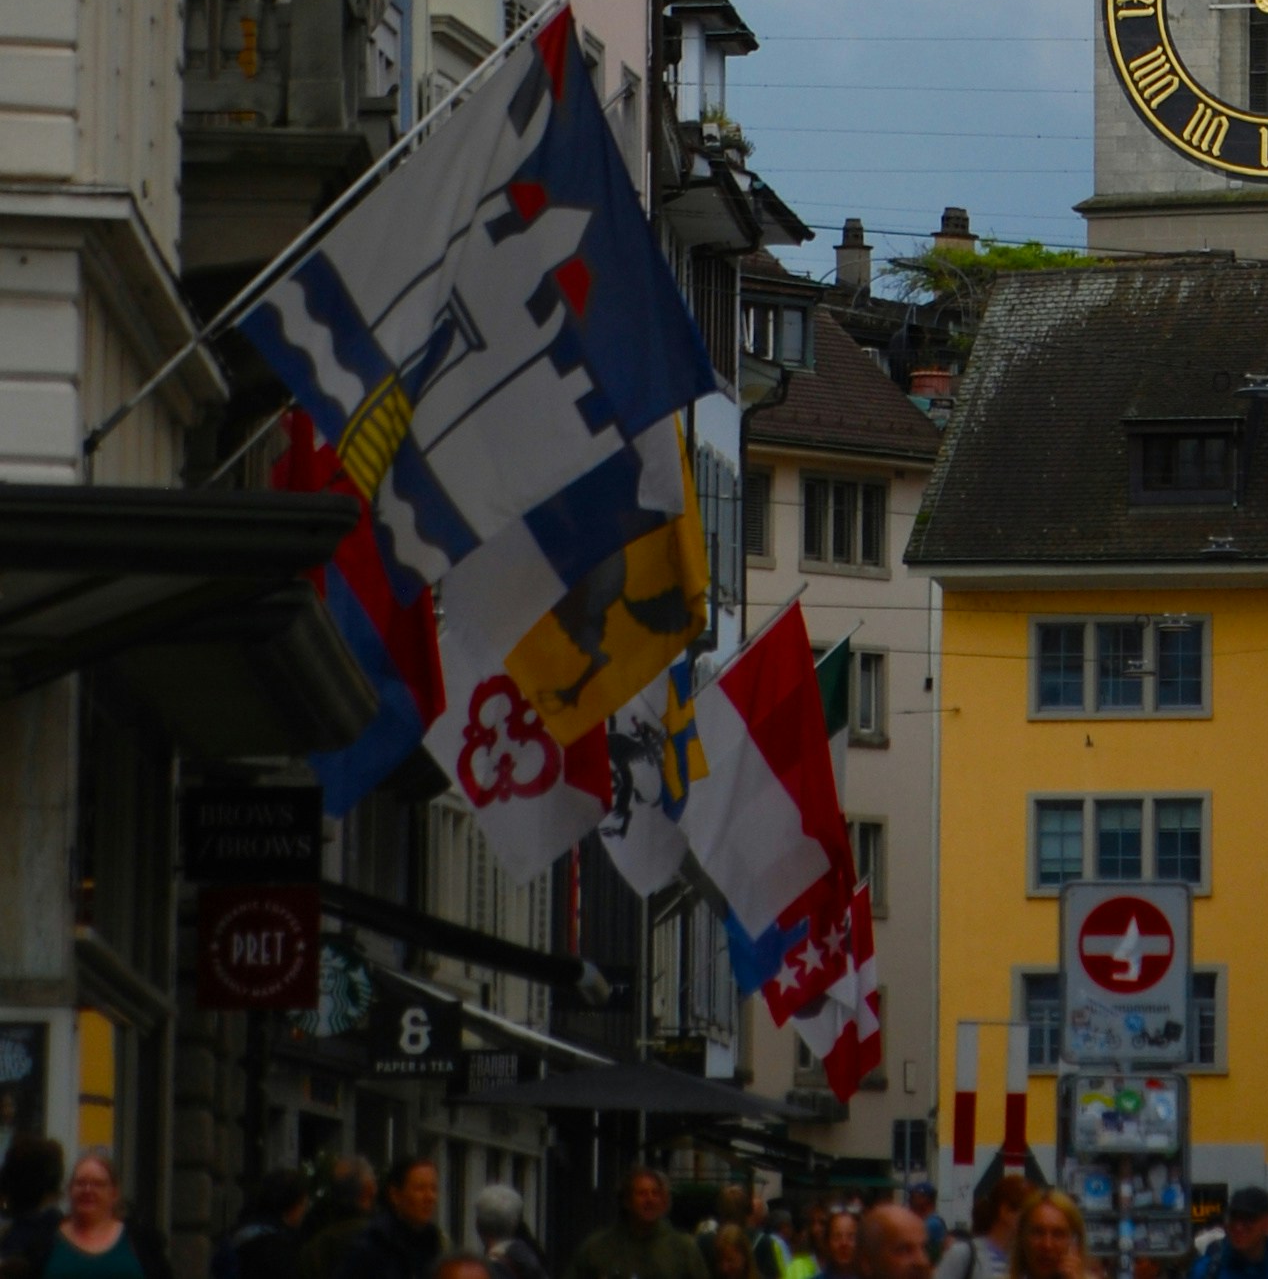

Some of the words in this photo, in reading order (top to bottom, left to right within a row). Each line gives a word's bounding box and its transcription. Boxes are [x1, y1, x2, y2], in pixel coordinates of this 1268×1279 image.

[231, 931, 286, 965] PRET
[376, 1060, 416, 1073] PAPER
[431, 1060, 455, 1073] TEA
